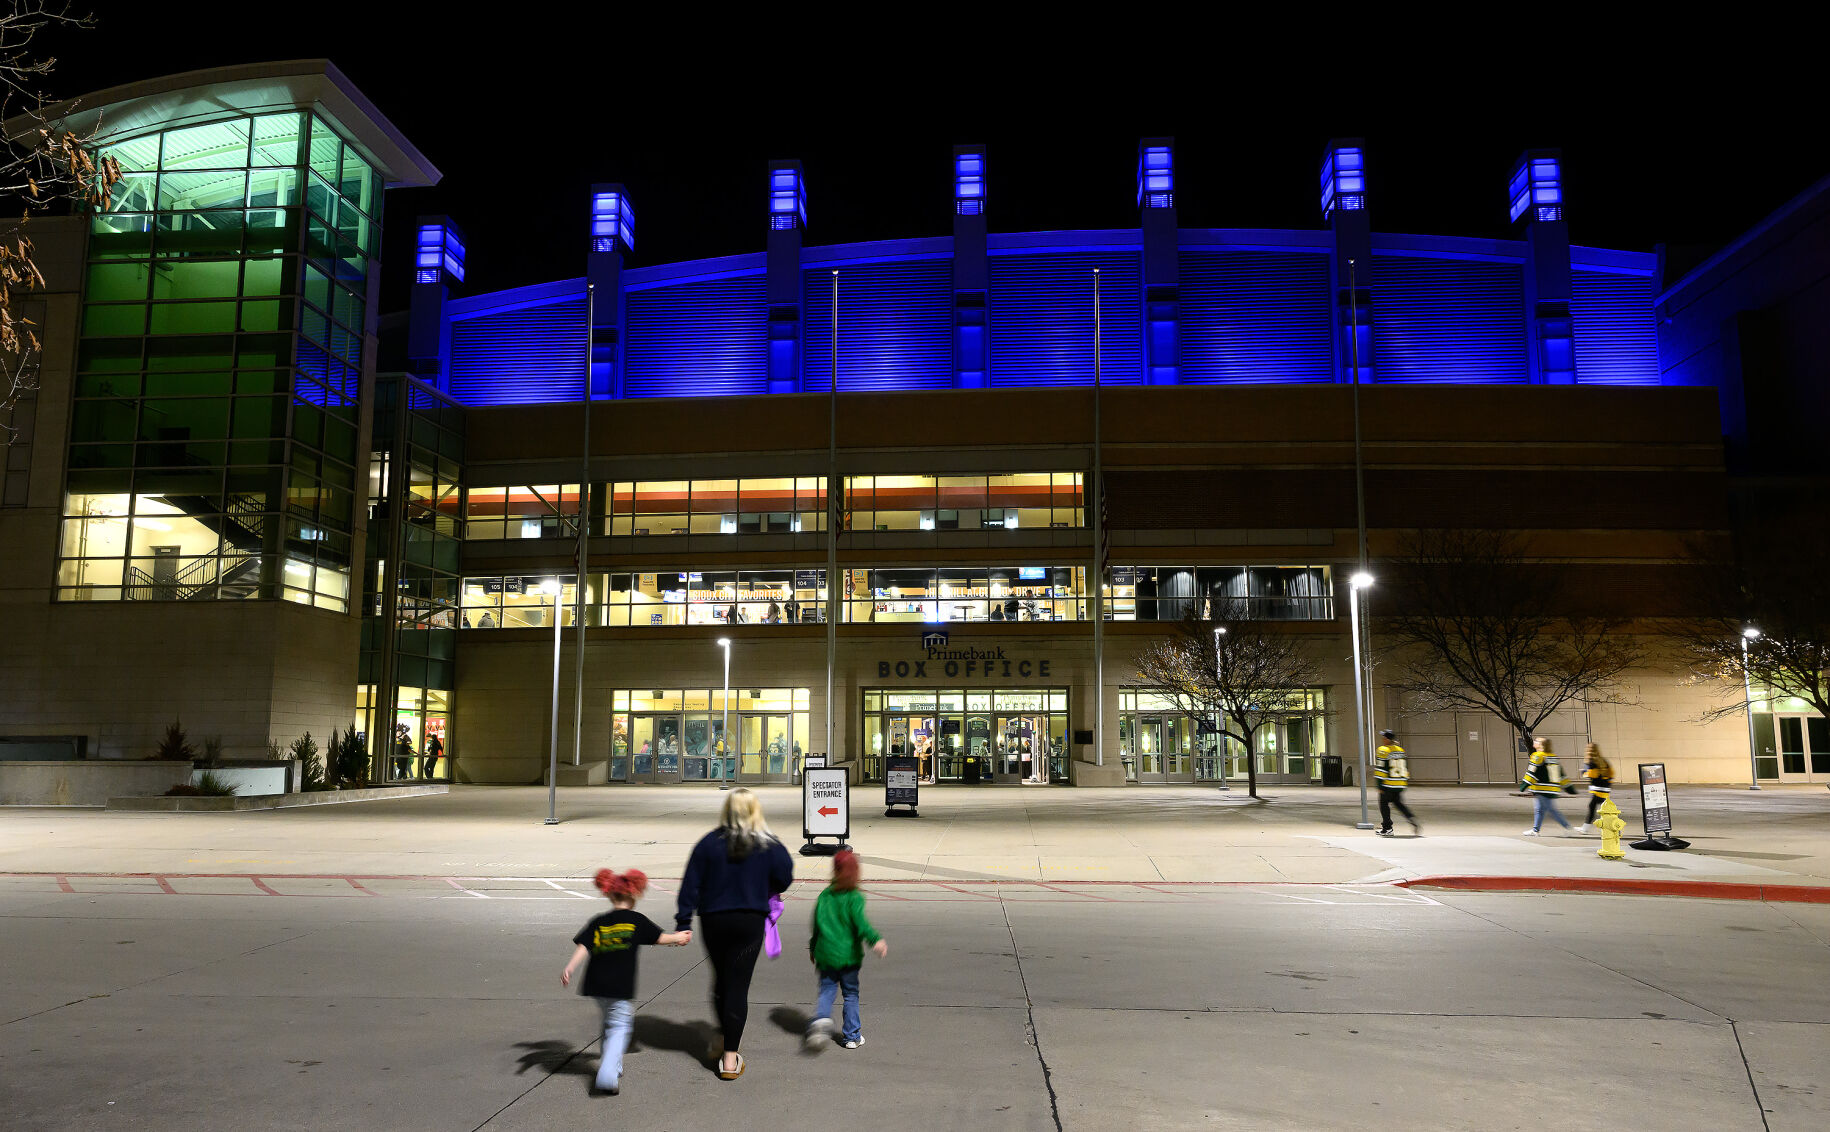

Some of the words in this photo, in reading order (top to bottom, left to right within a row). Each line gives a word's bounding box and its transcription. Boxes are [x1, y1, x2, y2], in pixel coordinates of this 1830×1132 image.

[693, 590, 717, 600] SIOUX
[739, 590, 782, 600] FAVORITES
[927, 646, 1007, 660] Primebank
[878, 661, 927, 678] BOX
[945, 661, 1050, 678] OFFICE
[812, 781, 842, 790] SPECTATOR
[813, 790, 842, 798] ENTRANCE
